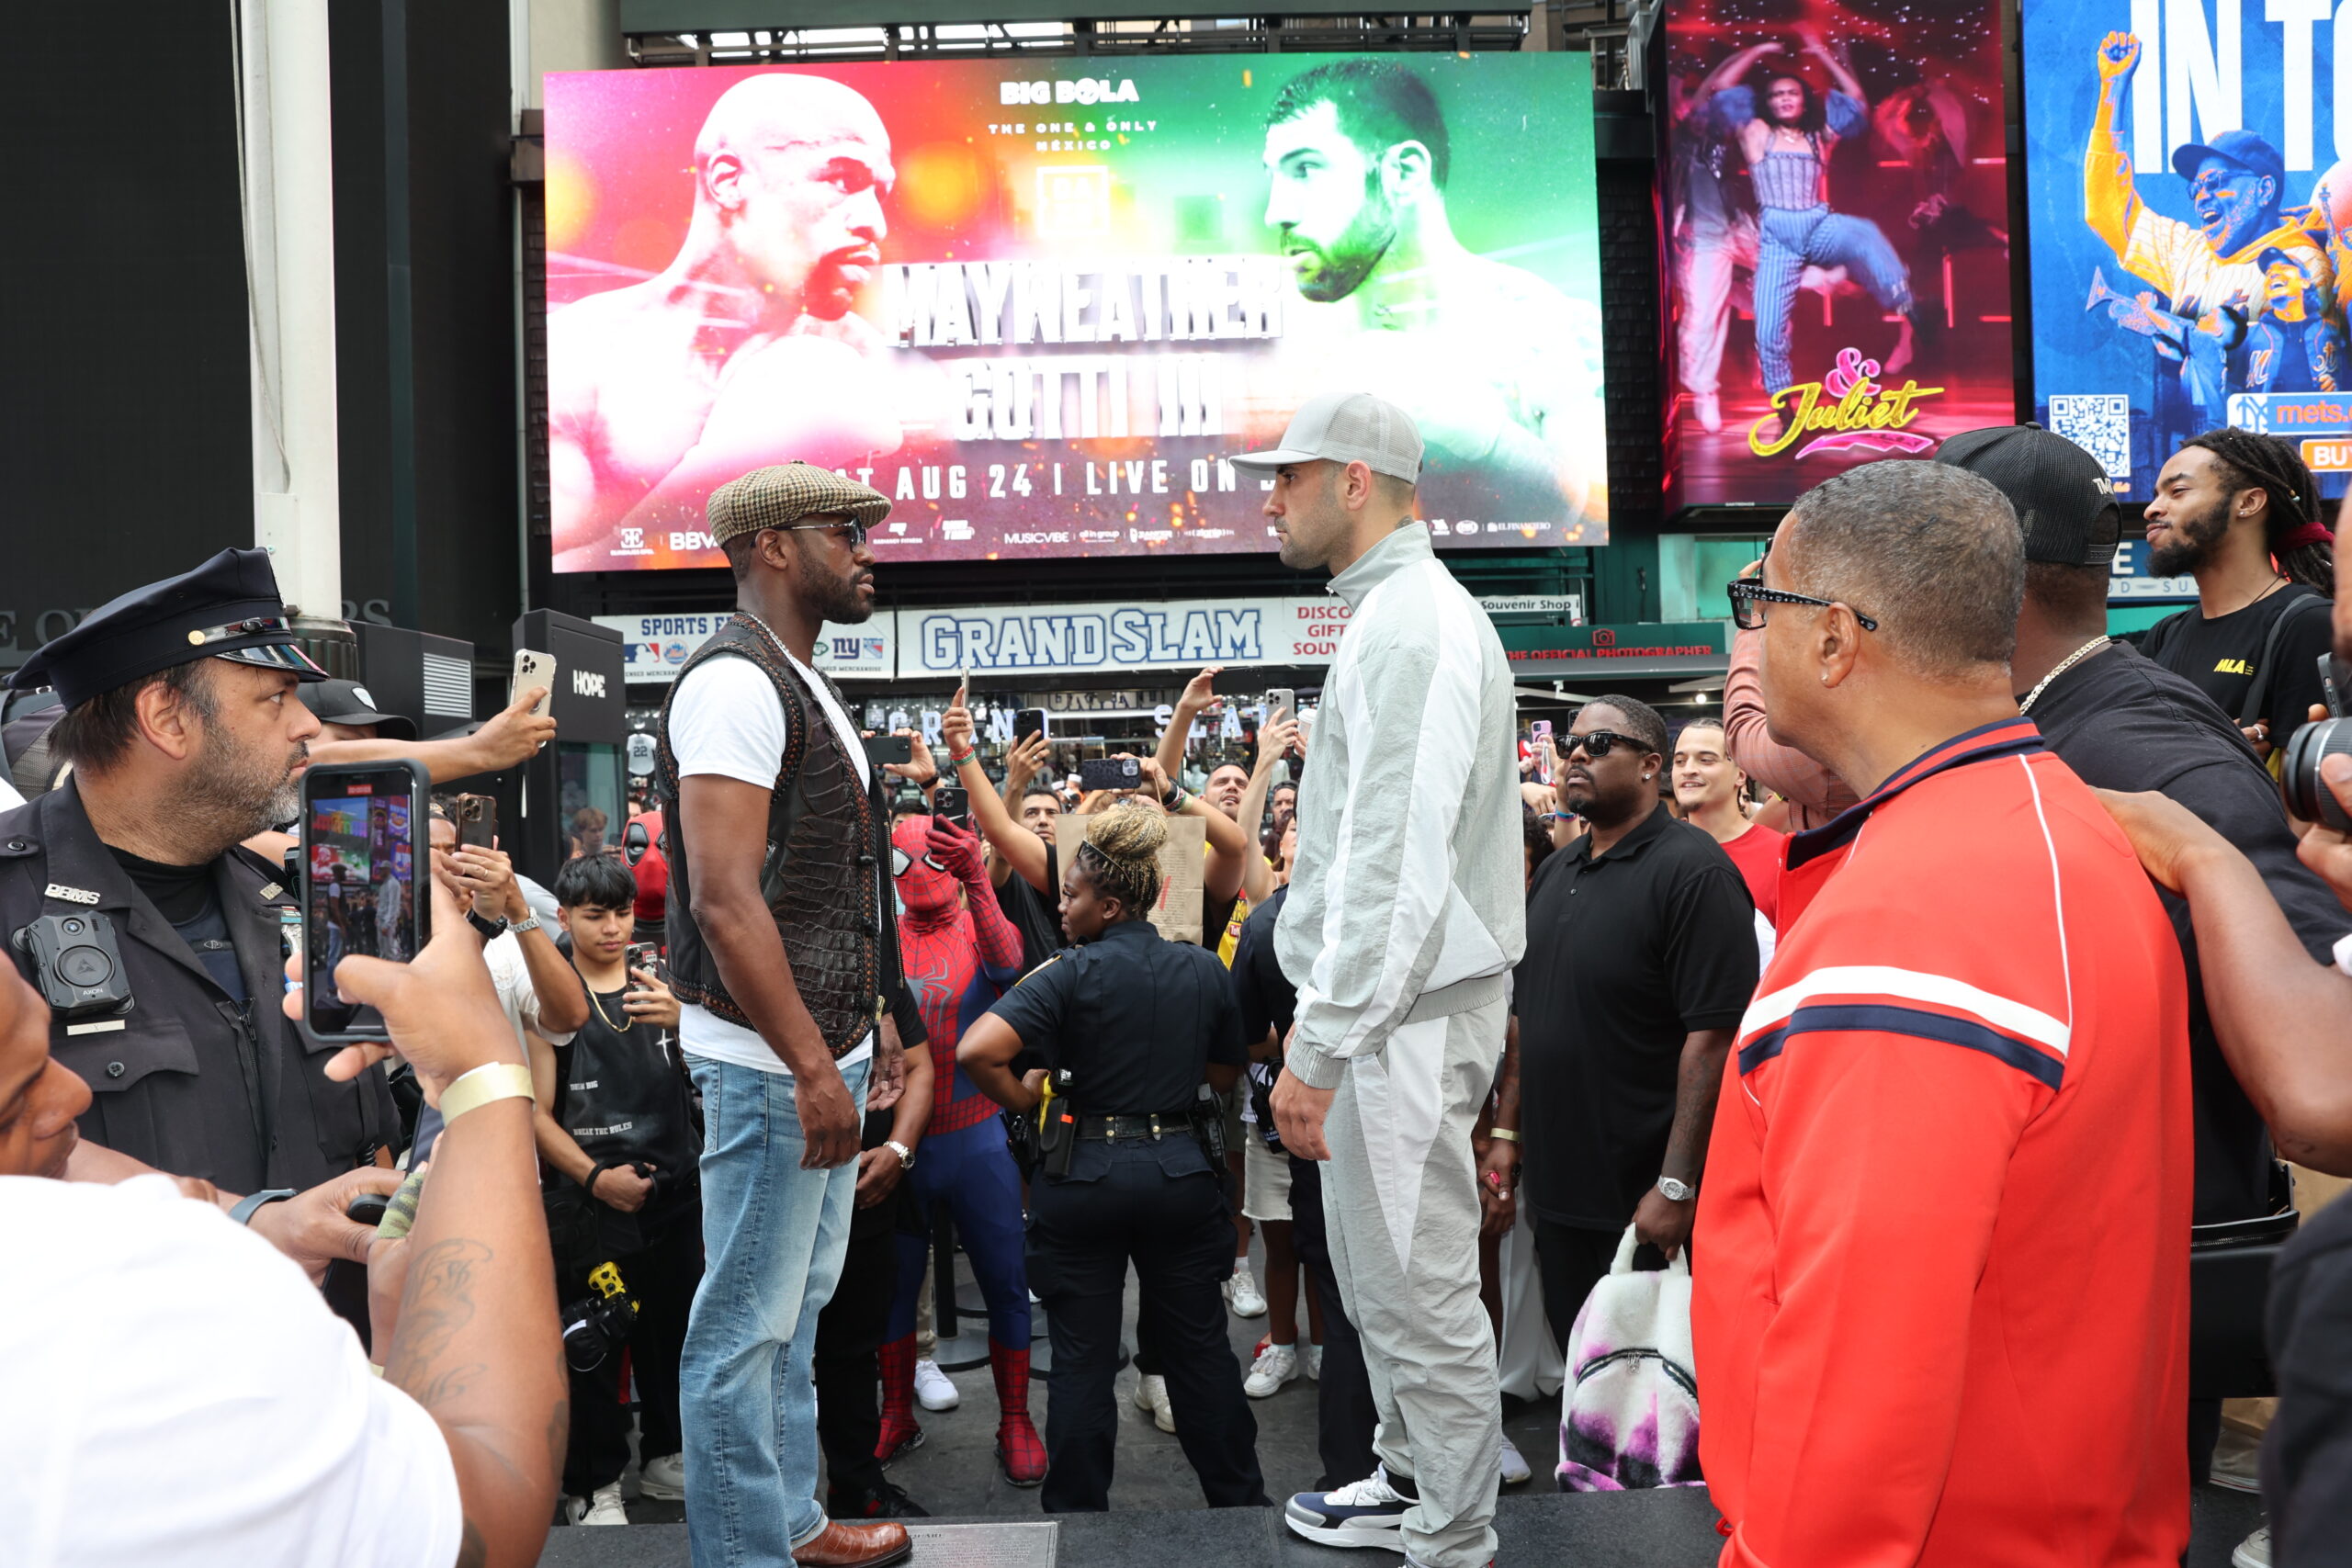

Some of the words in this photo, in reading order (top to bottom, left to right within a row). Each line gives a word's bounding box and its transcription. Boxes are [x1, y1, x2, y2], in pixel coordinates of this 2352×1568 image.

[1001, 81, 1050, 105] BIG
[1055, 77, 1139, 105] BOLA
[2130, 0, 2243, 174] IN
[988, 123, 1025, 134] THE
[1035, 122, 1074, 133] ONE
[1084, 121, 1095, 132] &
[1105, 120, 1157, 131] ONLY
[883, 256, 1283, 347] MAYWEATHER
[953, 355, 1129, 441] GOTTI
[1748, 377, 1944, 457] Juliet
[2277, 400, 2352, 423] mets.
[2313, 446, 2352, 466] BU
[895, 464, 967, 500] AUG
[989, 463, 1033, 498] 24
[1085, 459, 1169, 495] LIVE
[1190, 457, 1236, 493] ON
[1004, 532, 1069, 544] MUSICVIBE
[1481, 599, 1536, 610] Souvenir
[1539, 598, 1571, 611] Shop
[641, 617, 707, 636] SPORTS
[922, 615, 1106, 671] GRAND
[1112, 608, 1261, 663] SLAM
[1532, 648, 1592, 660] OFFICIAL
[1596, 645, 1713, 659] PHOTOGRAPHER
[2213, 659, 2246, 674] MLA
[573, 669, 606, 698] HOPE
[633, 745, 648, 757] 22
[45, 883, 101, 905] PBMS
[83, 987, 104, 996] AXON
[609, 1122, 632, 1134] RULES
